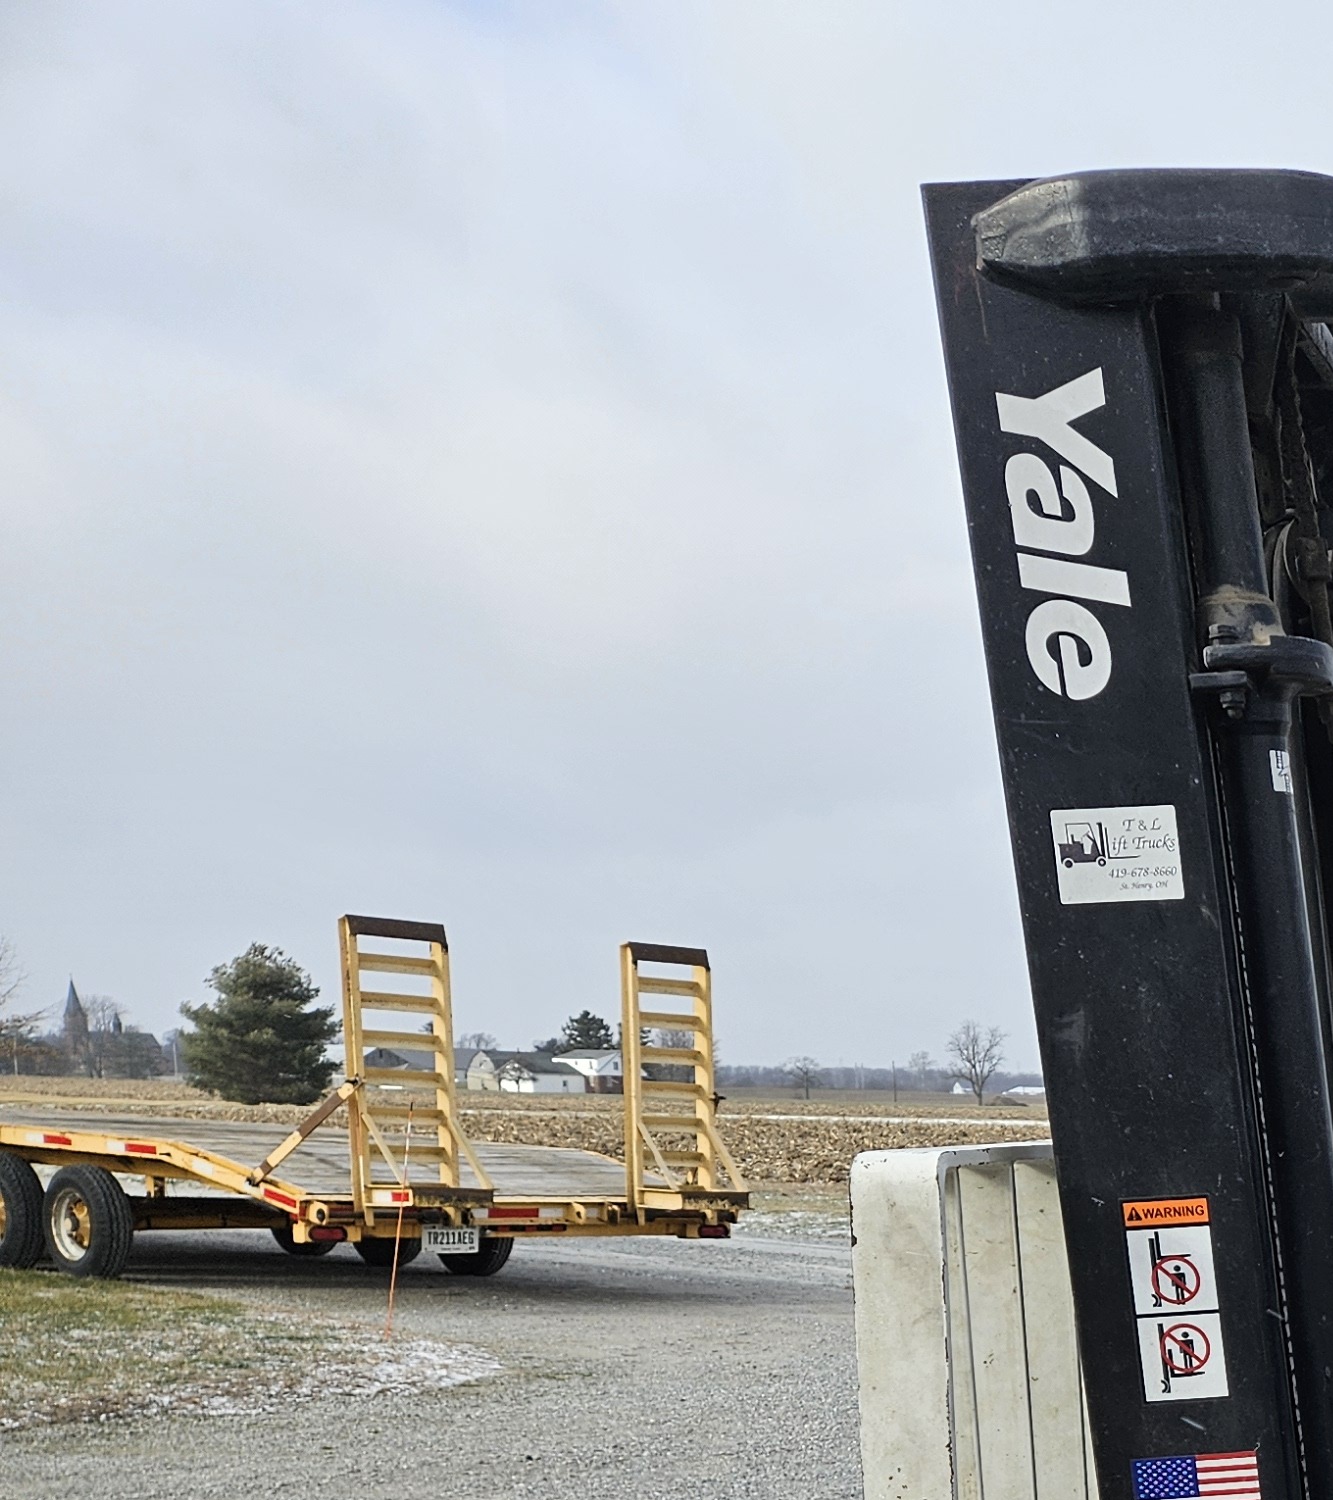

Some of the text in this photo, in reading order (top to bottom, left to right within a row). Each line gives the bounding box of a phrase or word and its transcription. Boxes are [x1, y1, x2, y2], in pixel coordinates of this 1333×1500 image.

[995, 367, 1132, 700] Yale
[1123, 818, 1162, 832] T & L
[1132, 834, 1176, 852] Trucks
[1109, 866, 1178, 879] 419-678-8660
[1142, 1204, 1205, 1220] WARNING
